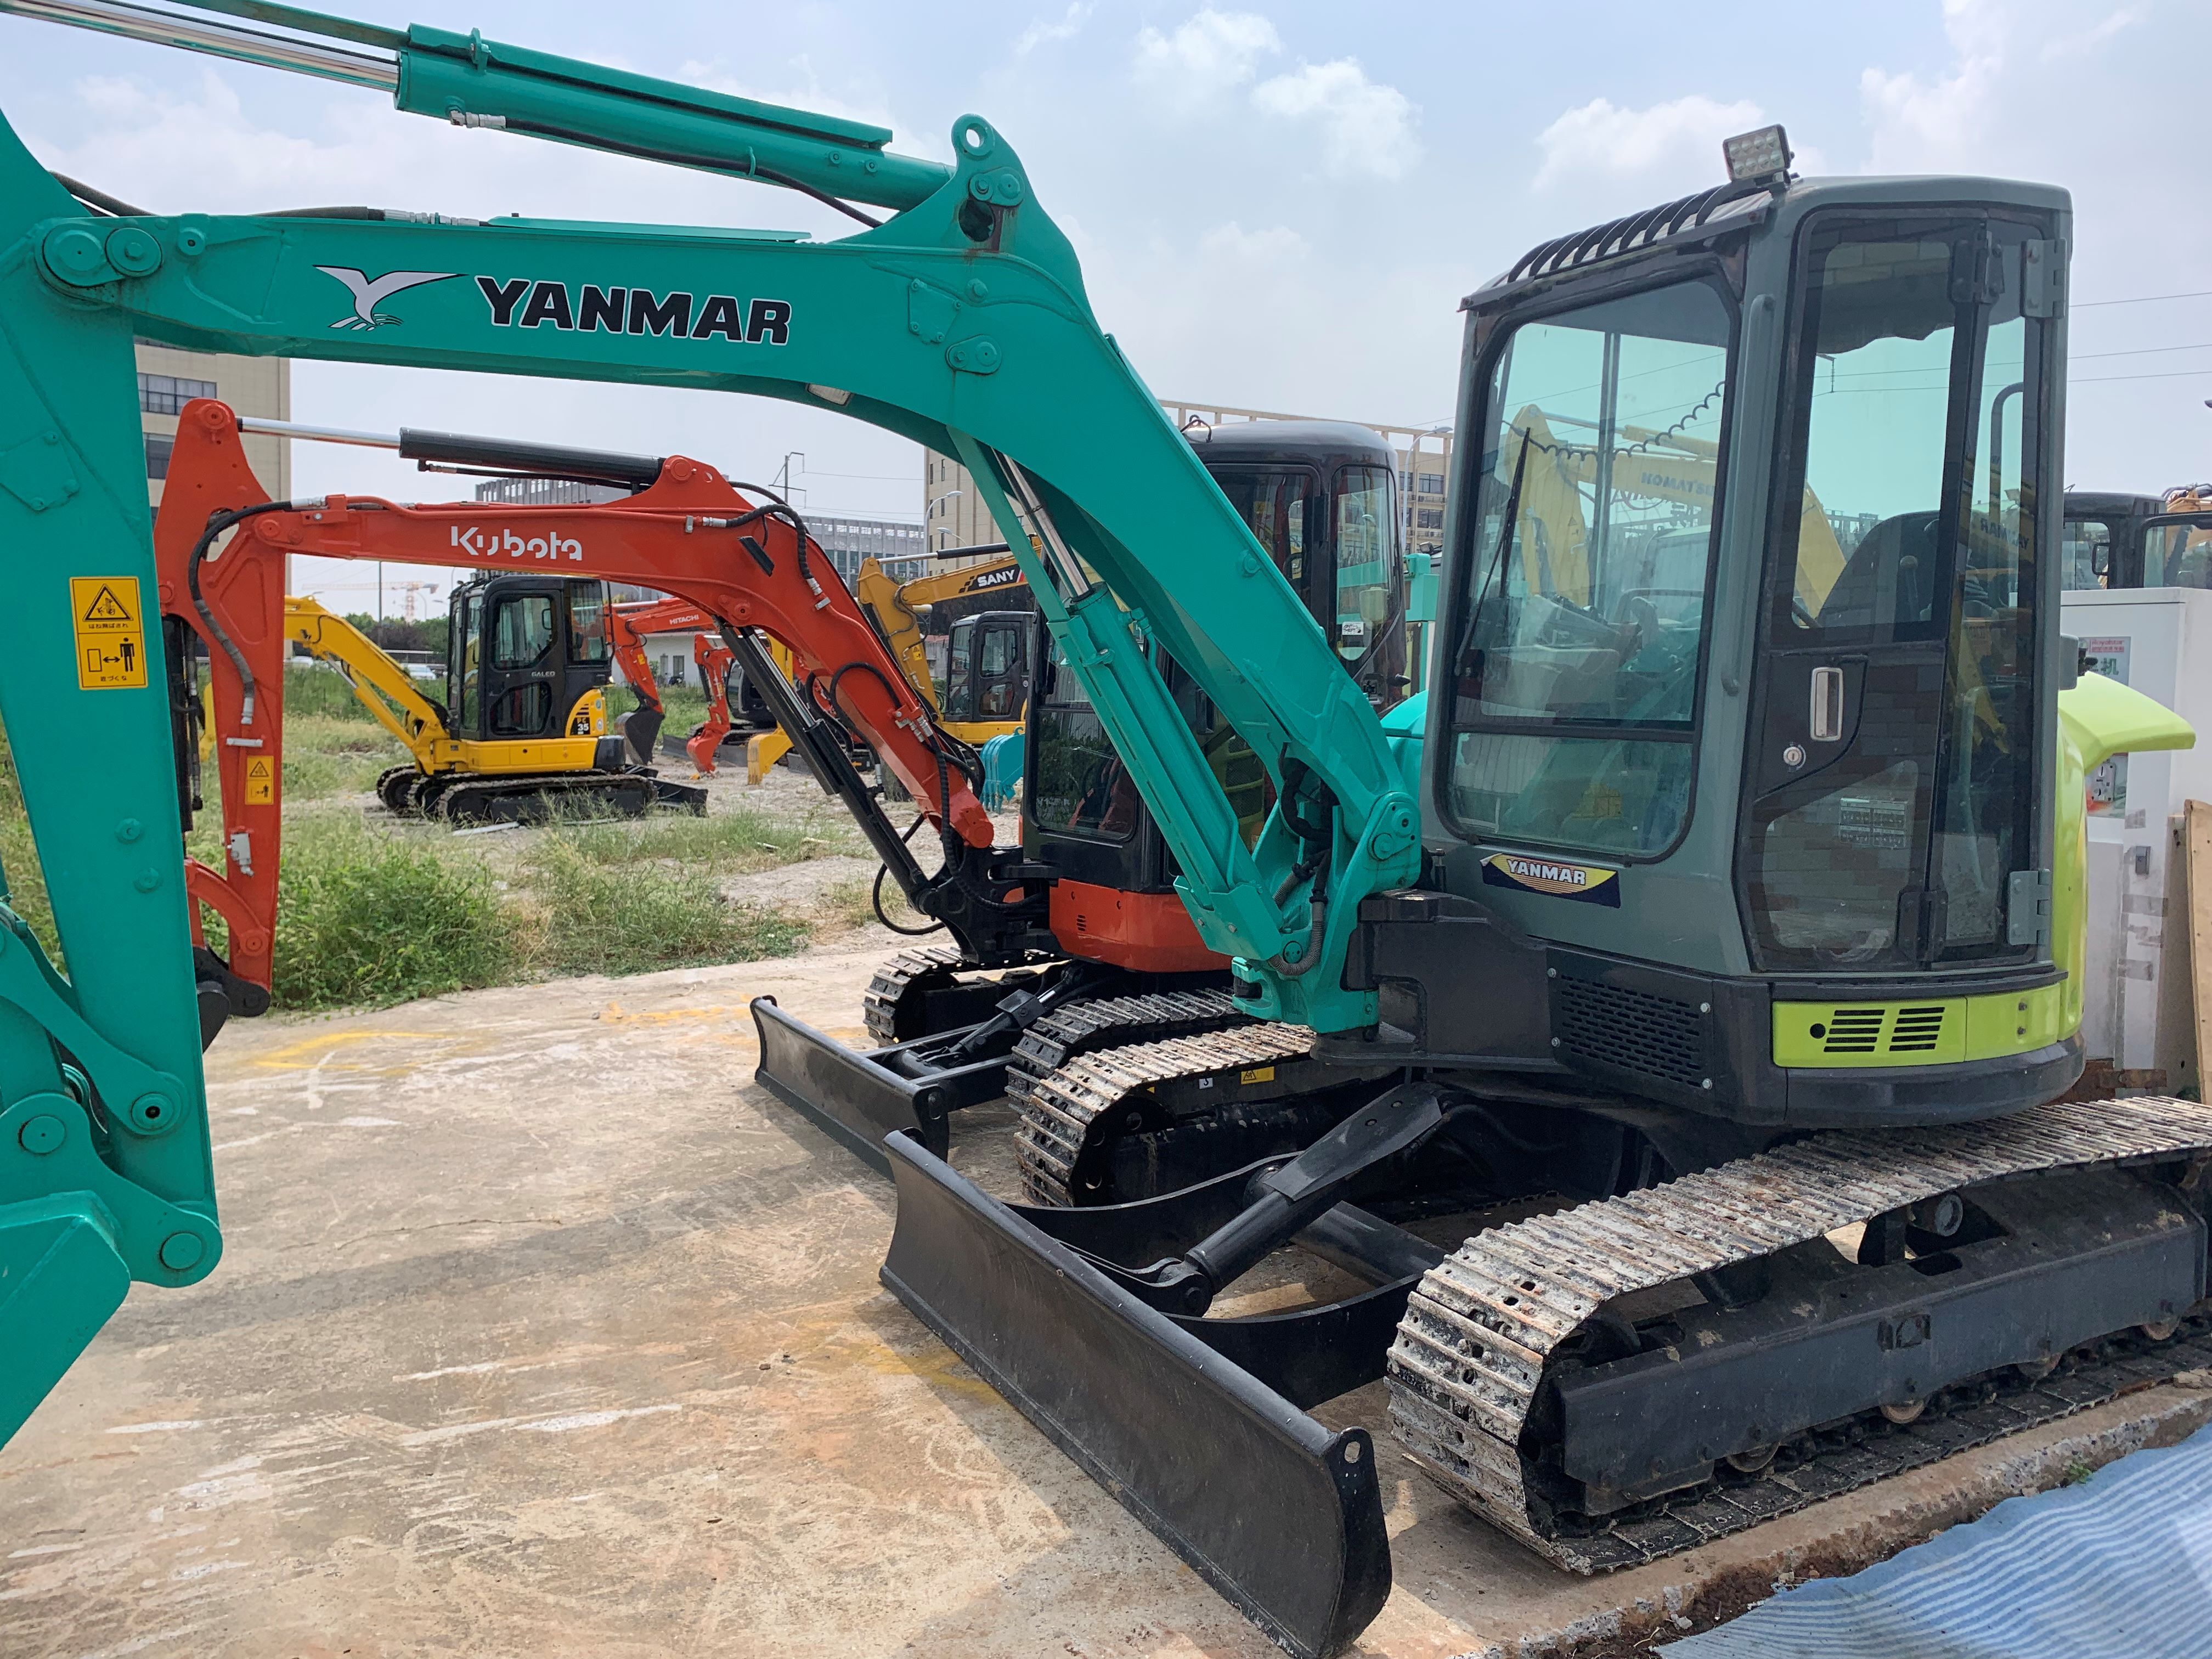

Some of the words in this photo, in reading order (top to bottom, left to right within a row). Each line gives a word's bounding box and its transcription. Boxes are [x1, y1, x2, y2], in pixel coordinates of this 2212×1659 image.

[474, 275, 792, 346] YANMAR
[451, 525, 583, 561] Kubota
[977, 569, 1015, 587] SANY
[669, 614, 699, 625] HITACHI
[578, 723, 589, 731] 35
[1507, 859, 1586, 885] YANMAR
